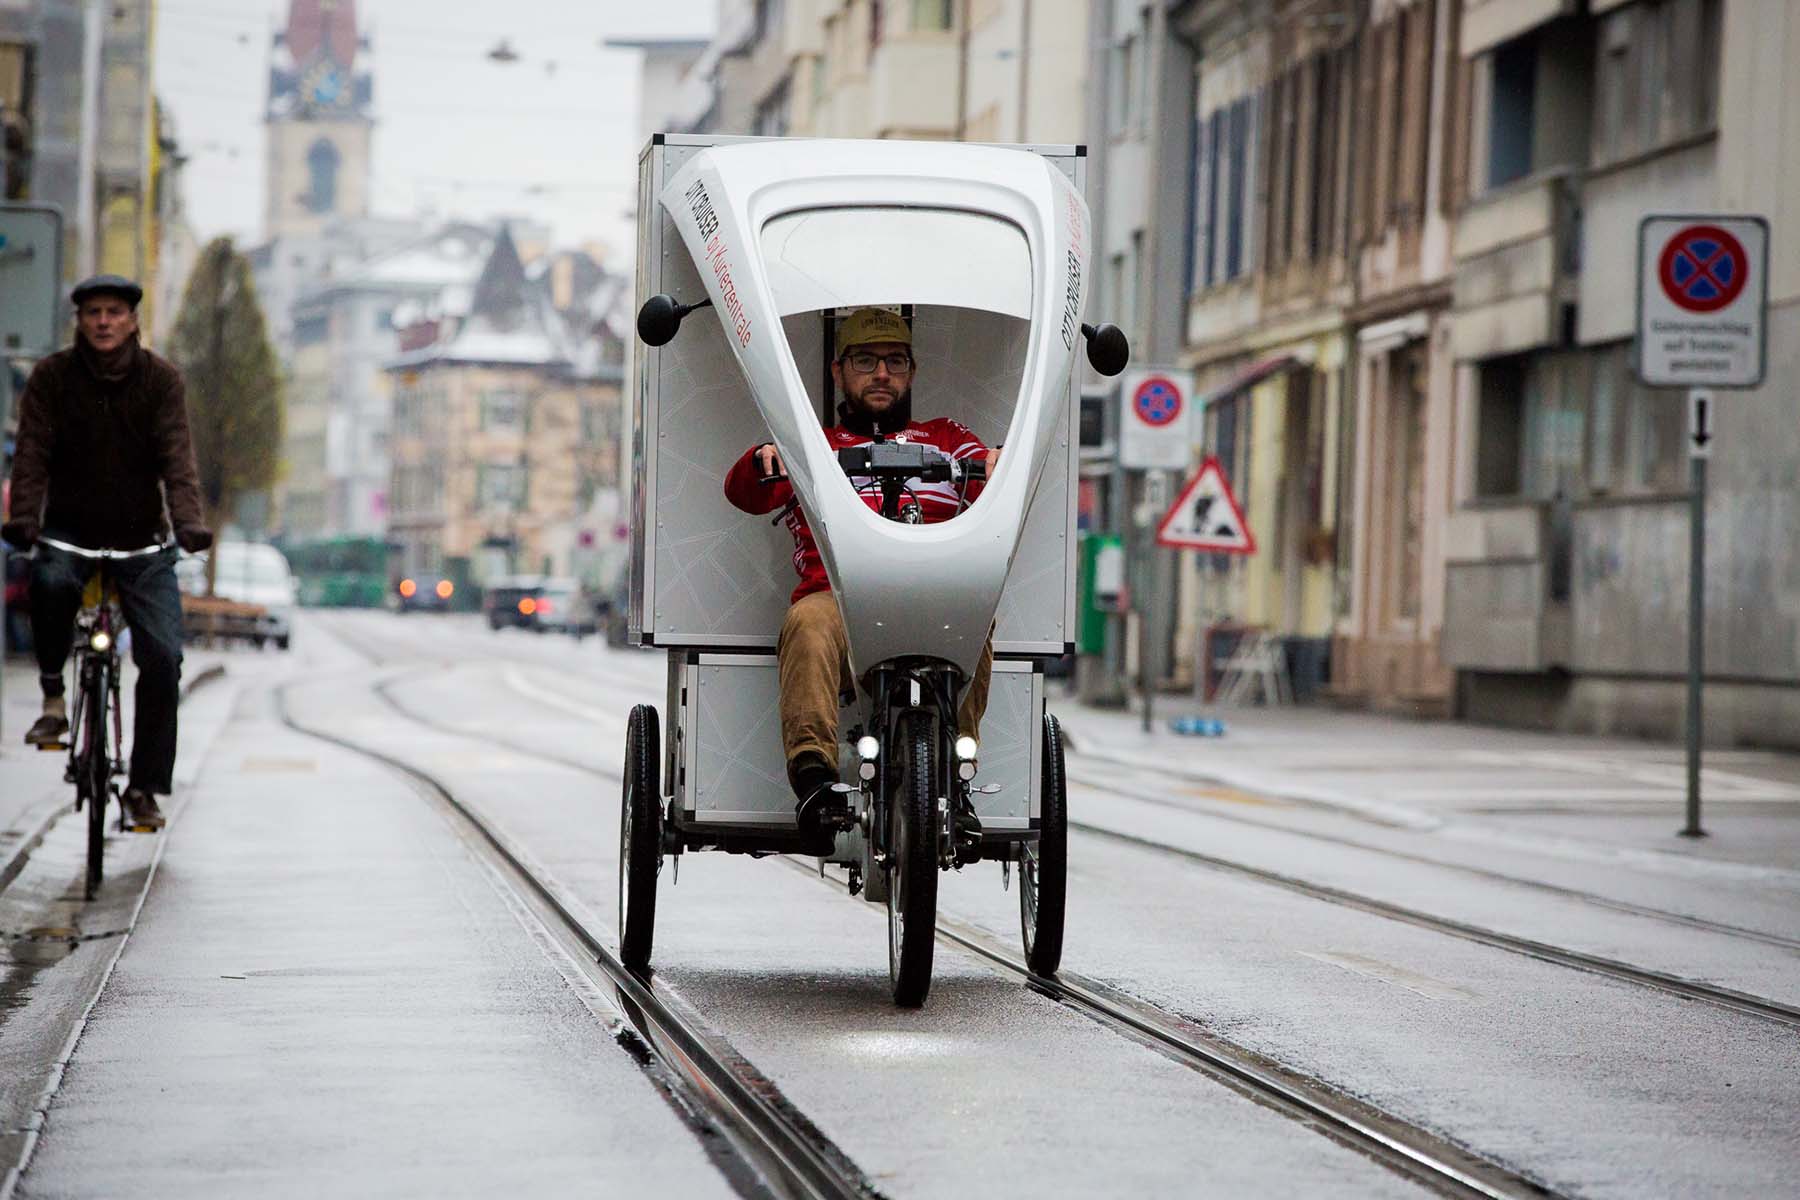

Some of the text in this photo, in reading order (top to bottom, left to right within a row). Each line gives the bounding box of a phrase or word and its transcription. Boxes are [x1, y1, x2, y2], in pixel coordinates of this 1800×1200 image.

[691, 193, 720, 243] CRUISER
[705, 231, 721, 260] by
[712, 244, 752, 348] Kurierzentrale
[1066, 249, 1081, 316] CRUISER
[1061, 305, 1076, 352] CITY
